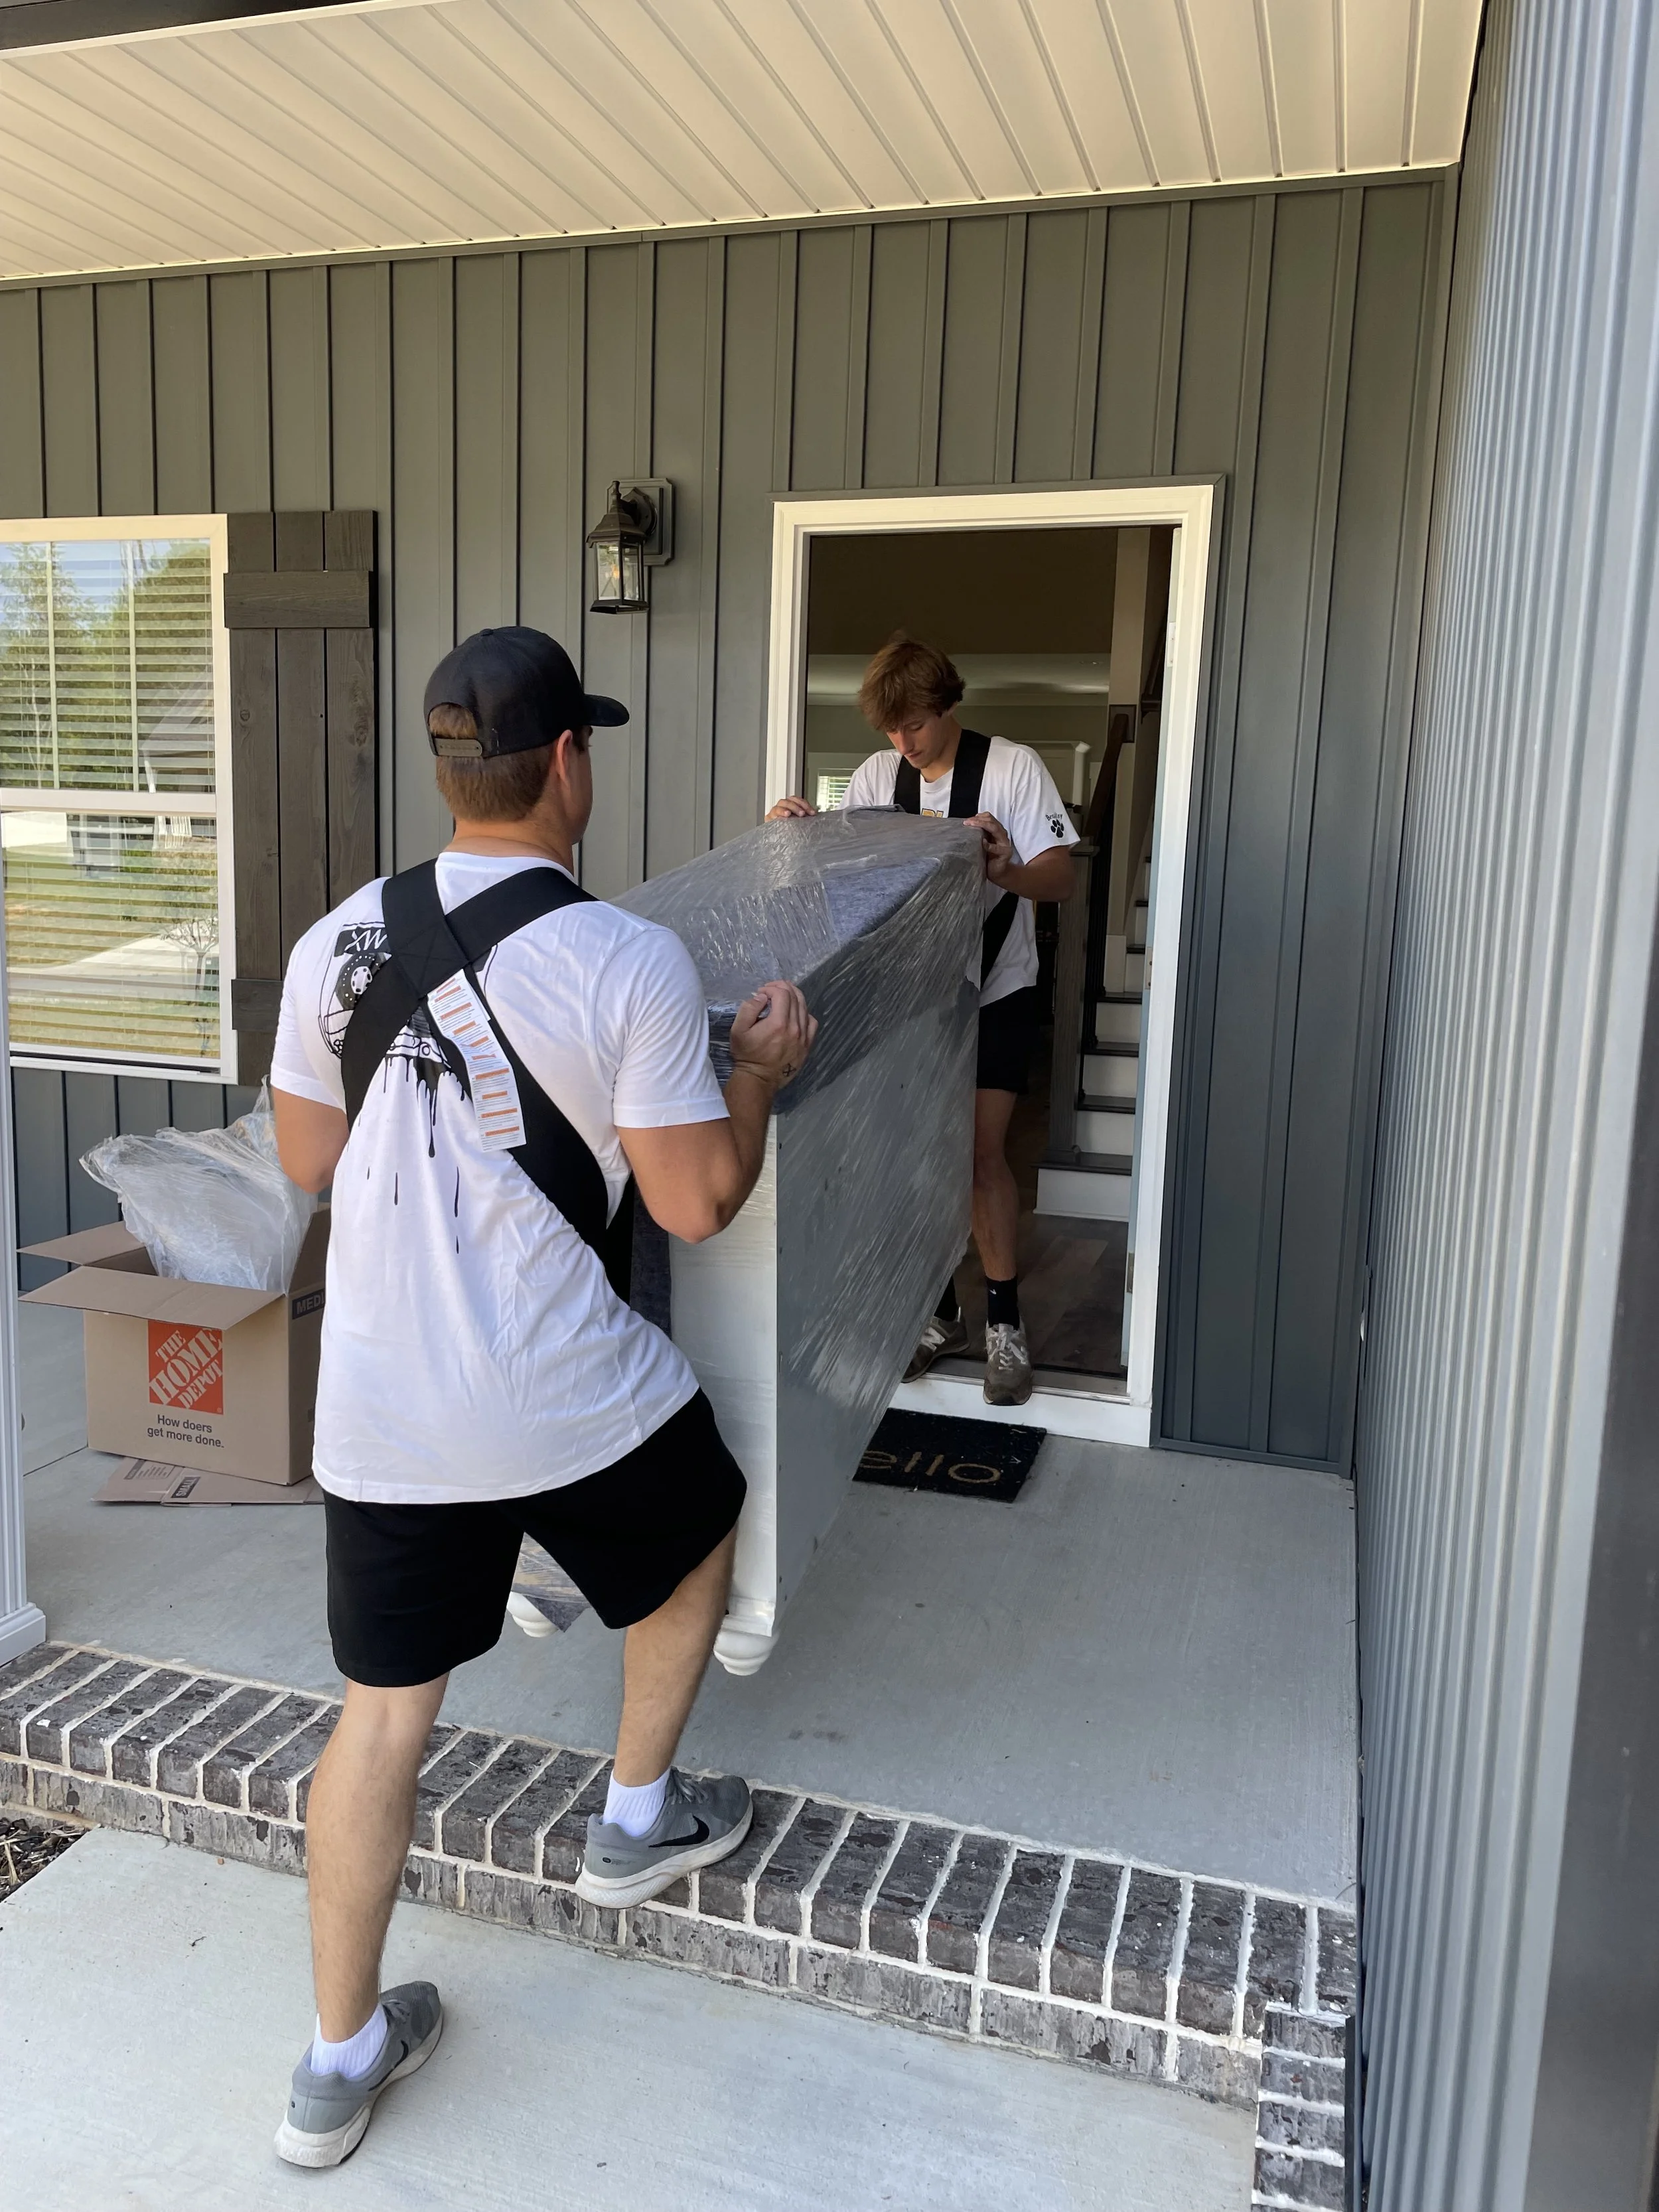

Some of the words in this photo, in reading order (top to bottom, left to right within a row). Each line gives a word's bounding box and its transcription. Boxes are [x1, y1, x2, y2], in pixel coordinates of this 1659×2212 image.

[297, 1291, 325, 1314] MEDI
[155, 1329, 186, 1363] THE
[149, 1328, 222, 1405] HOME
[177, 1359, 223, 1409] DEPOT
[147, 1427, 164, 1438] get
[167, 1430, 192, 1442] more
[195, 1434, 225, 1448] done.
[157, 1414, 180, 1427] How
[183, 1419, 212, 1433] doers
[861, 1450, 1001, 1484] ello
[175, 1477, 198, 1497] SMALL
